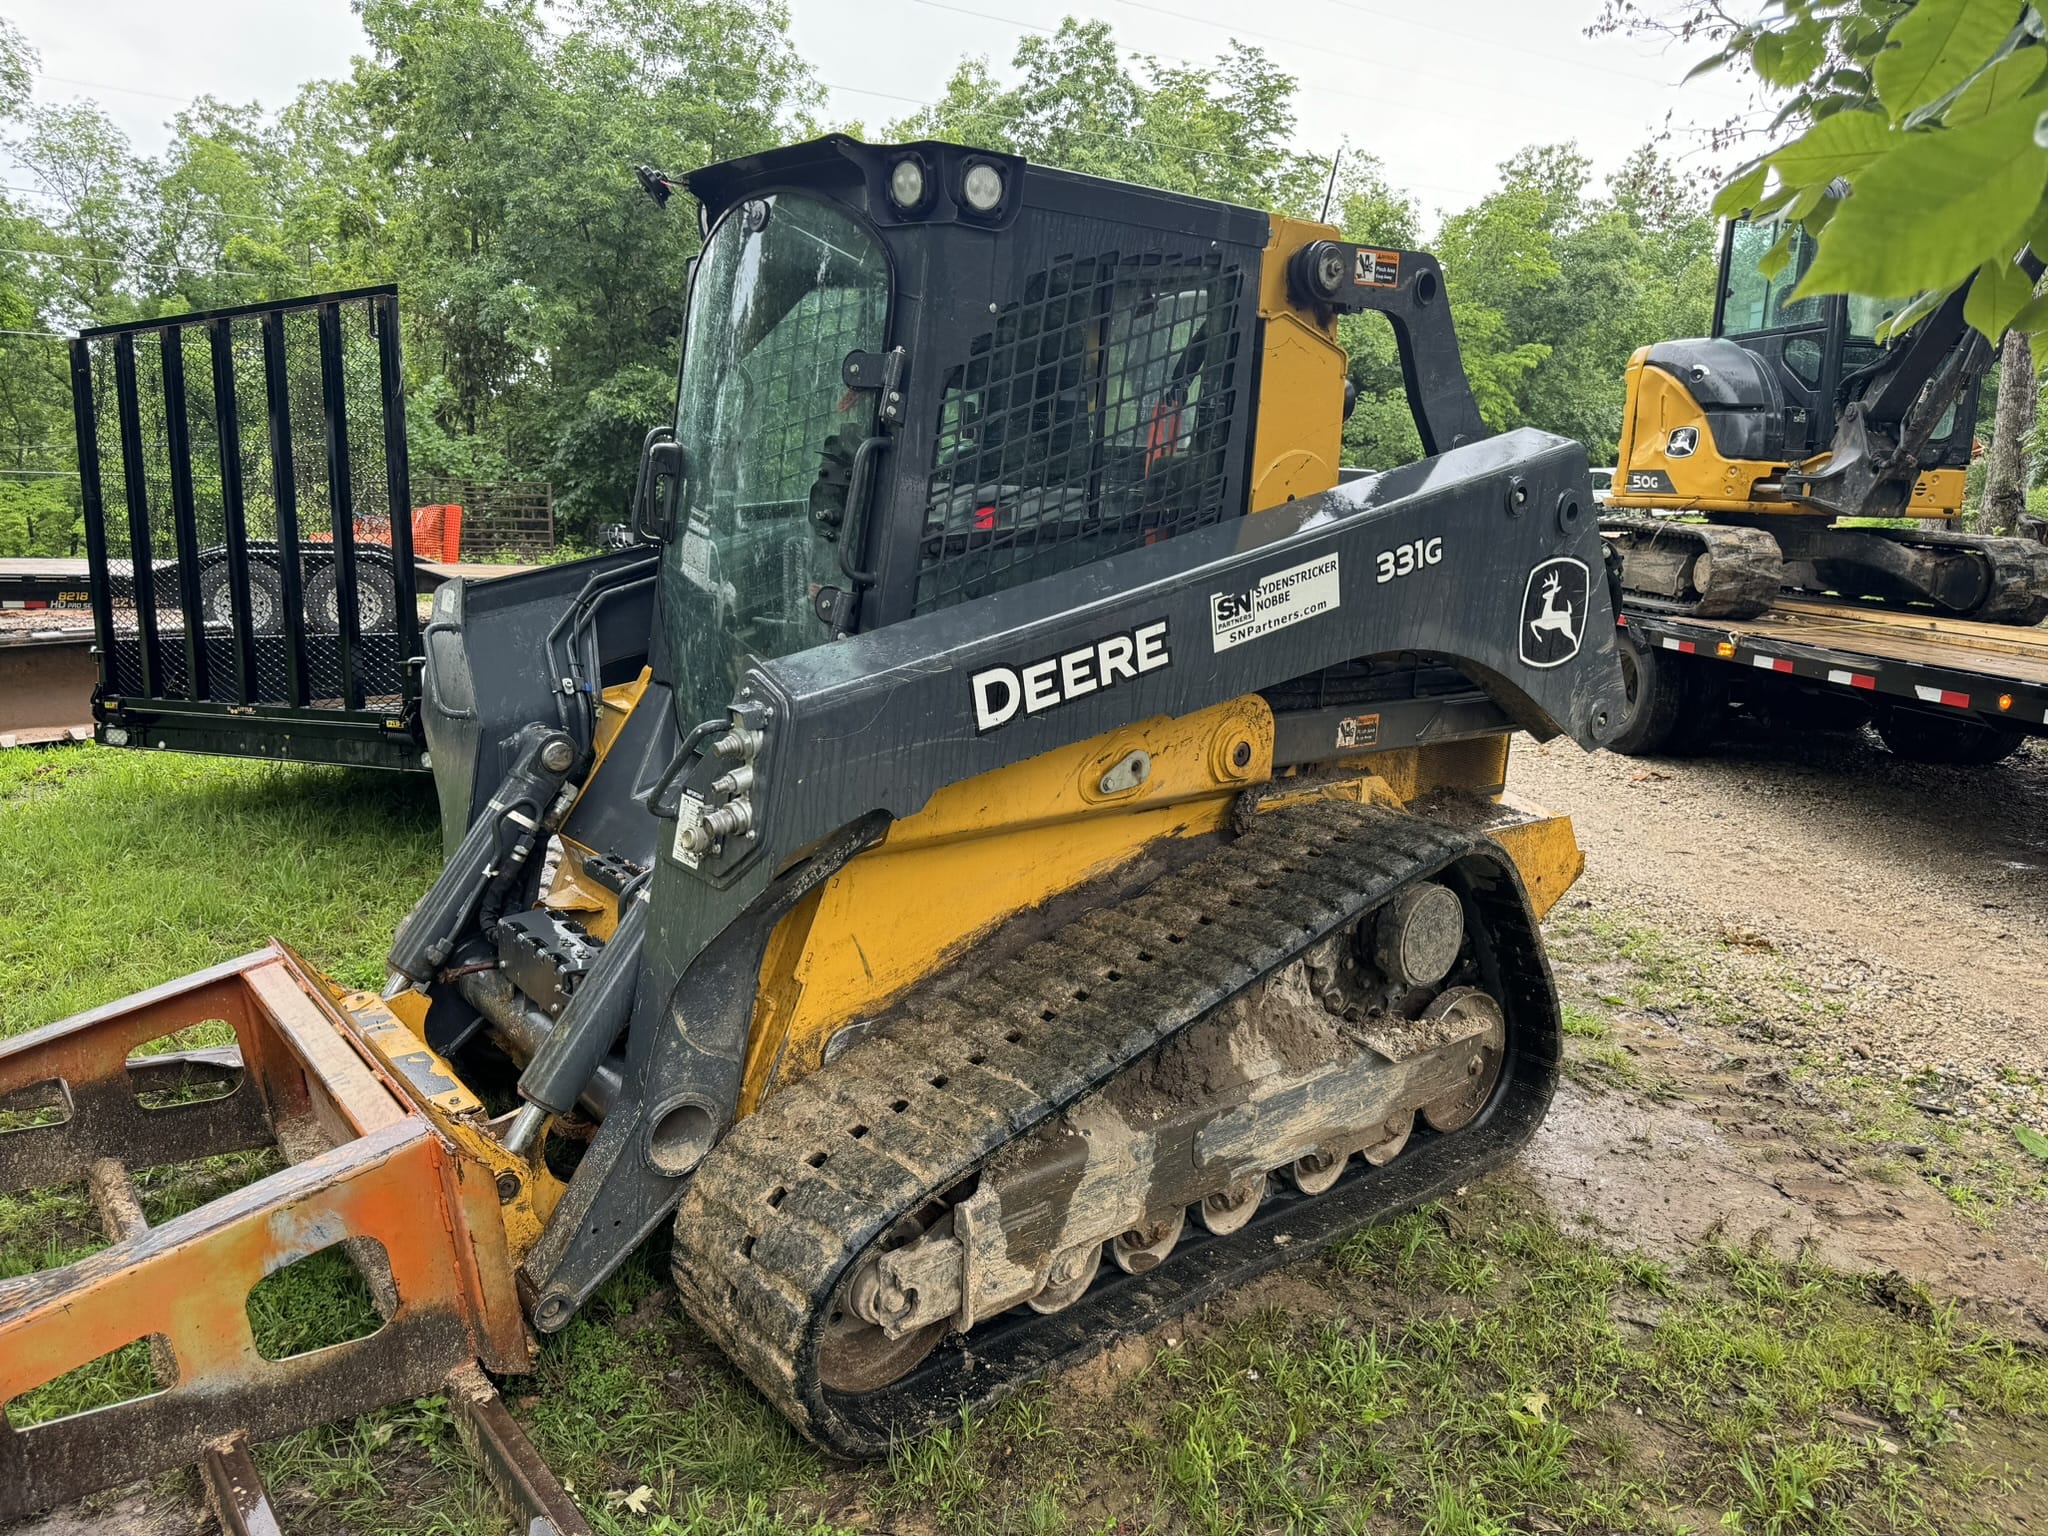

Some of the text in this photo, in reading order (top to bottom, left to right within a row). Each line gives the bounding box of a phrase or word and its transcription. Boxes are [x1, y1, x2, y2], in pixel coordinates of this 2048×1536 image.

[1633, 475, 1658, 488] 50G
[1376, 536, 1442, 583] 331G
[1256, 560, 1337, 598] SYDENSTRICKER
[50, 600, 66, 609] HD
[58, 591, 89, 601] 8218
[1217, 590, 1252, 621] SN
[1256, 590, 1291, 612] NOBBE
[1218, 613, 1252, 631] PARTNERS
[1229, 600, 1327, 643] SNPartners.com
[972, 621, 1169, 731] DEERE
